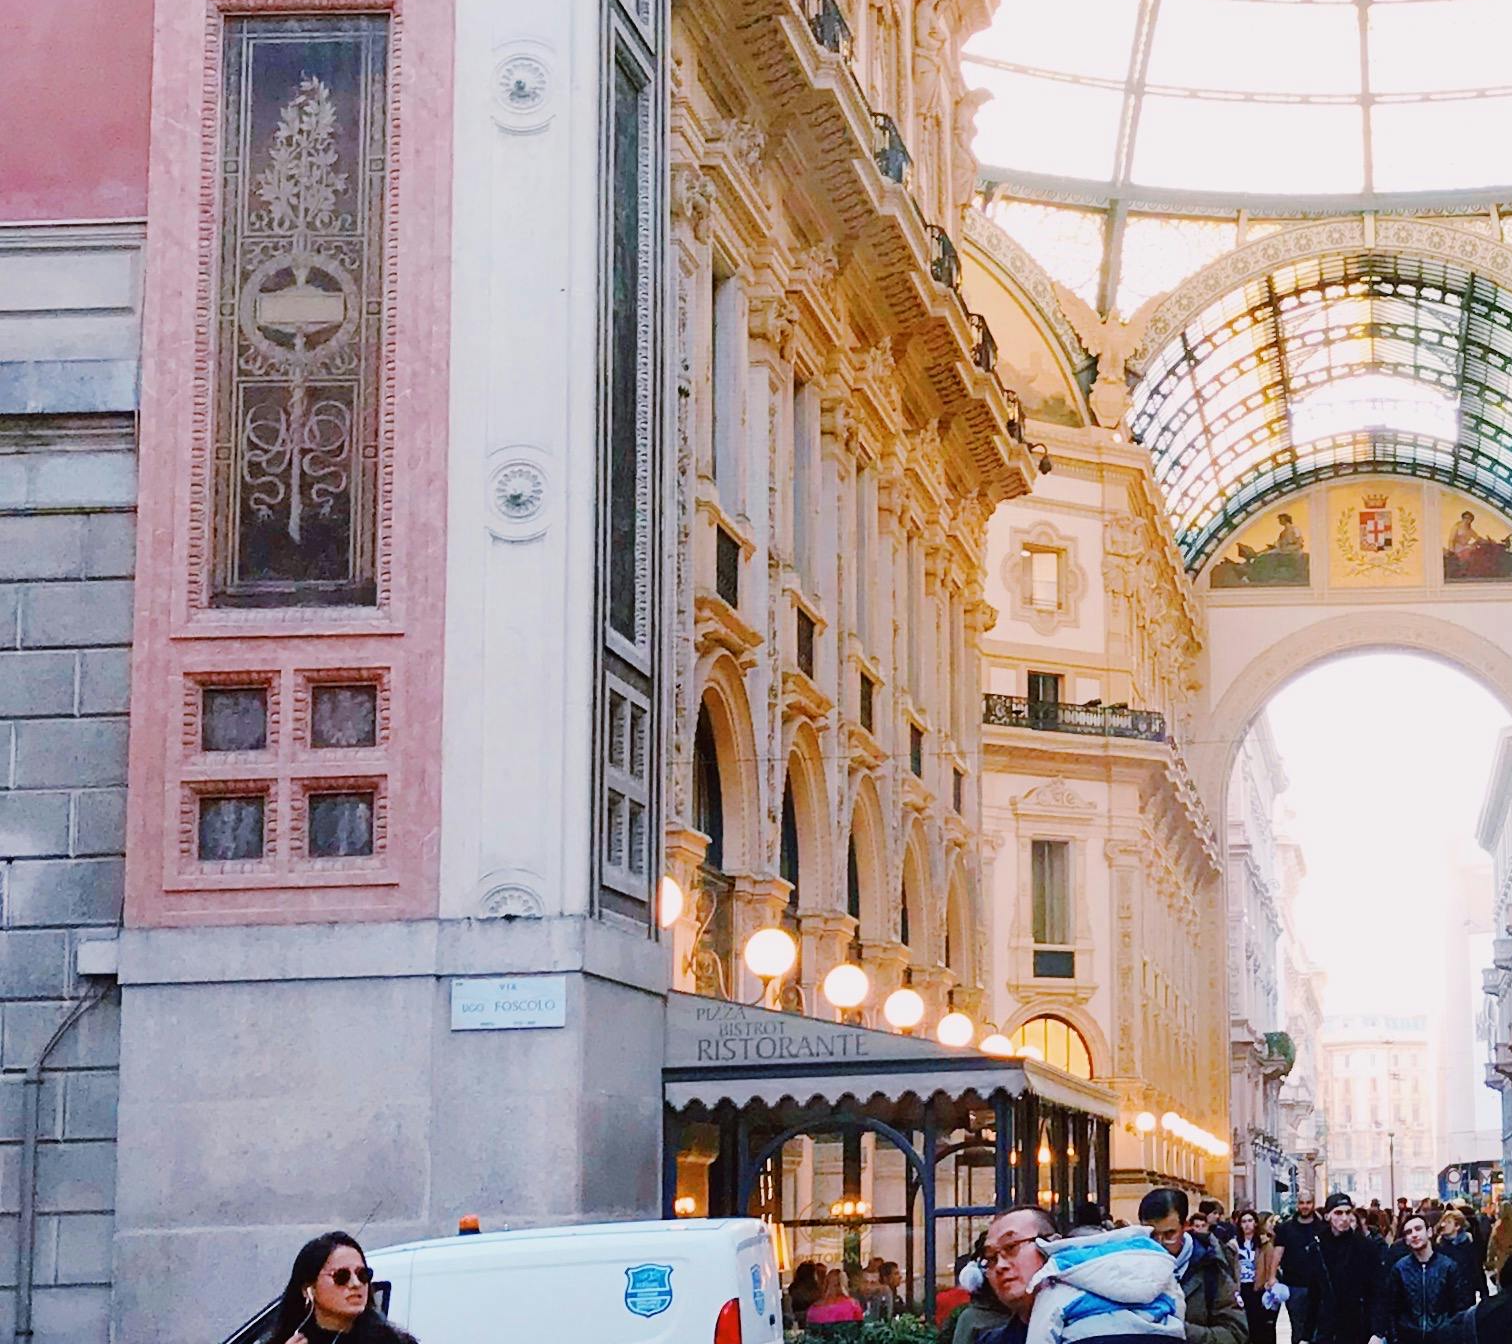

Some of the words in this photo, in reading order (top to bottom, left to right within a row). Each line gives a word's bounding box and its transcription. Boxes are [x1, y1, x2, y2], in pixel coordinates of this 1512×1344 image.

[494, 999, 556, 1012] FOSCOLO
[696, 1006, 747, 1021] PIZZA
[719, 1021, 785, 1037] BISTROT
[697, 1033, 870, 1061] RISTORANTE
